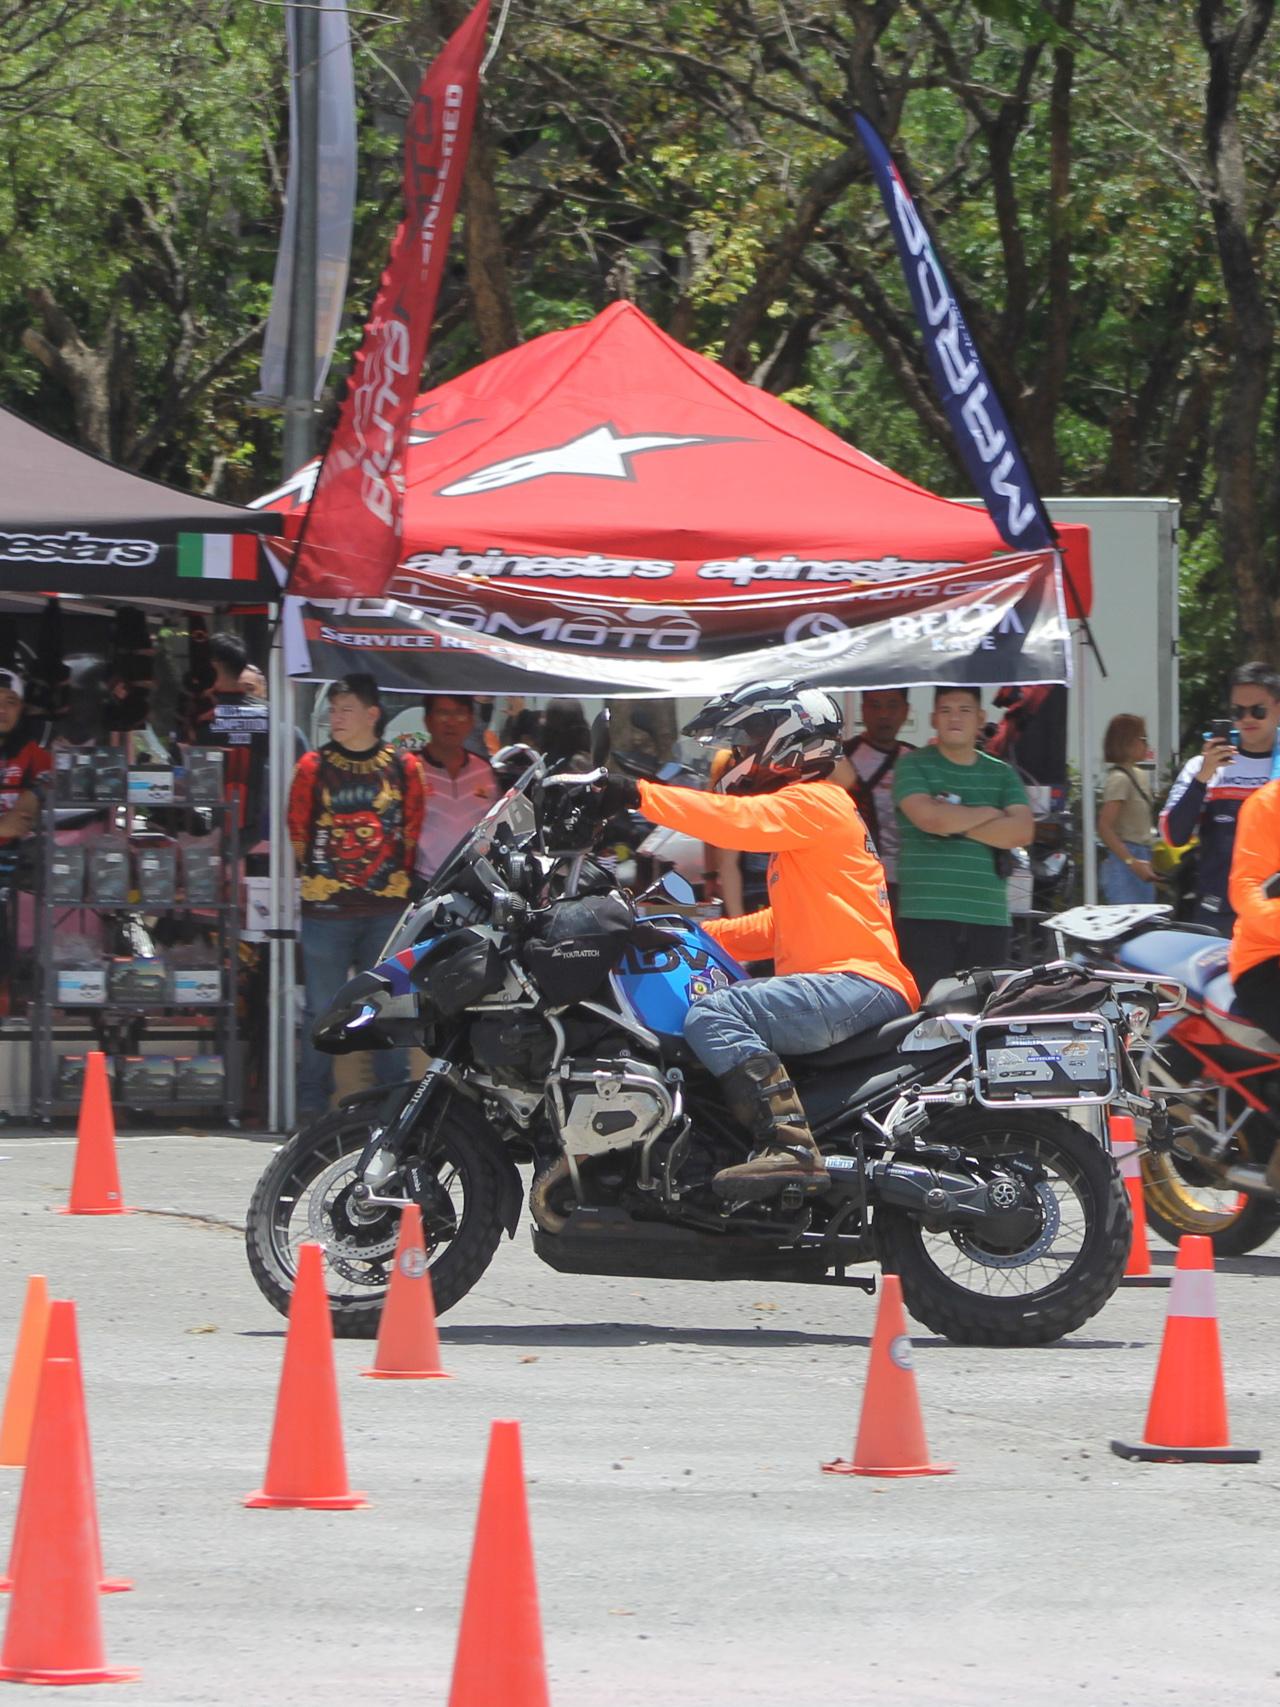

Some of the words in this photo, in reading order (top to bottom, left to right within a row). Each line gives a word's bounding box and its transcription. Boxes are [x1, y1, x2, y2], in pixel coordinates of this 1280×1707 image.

[0, 532, 159, 566] estars
[404, 547, 675, 578] alpinestars
[320, 626, 434, 648] SERVICE
[562, 949, 600, 959] TOURATECH
